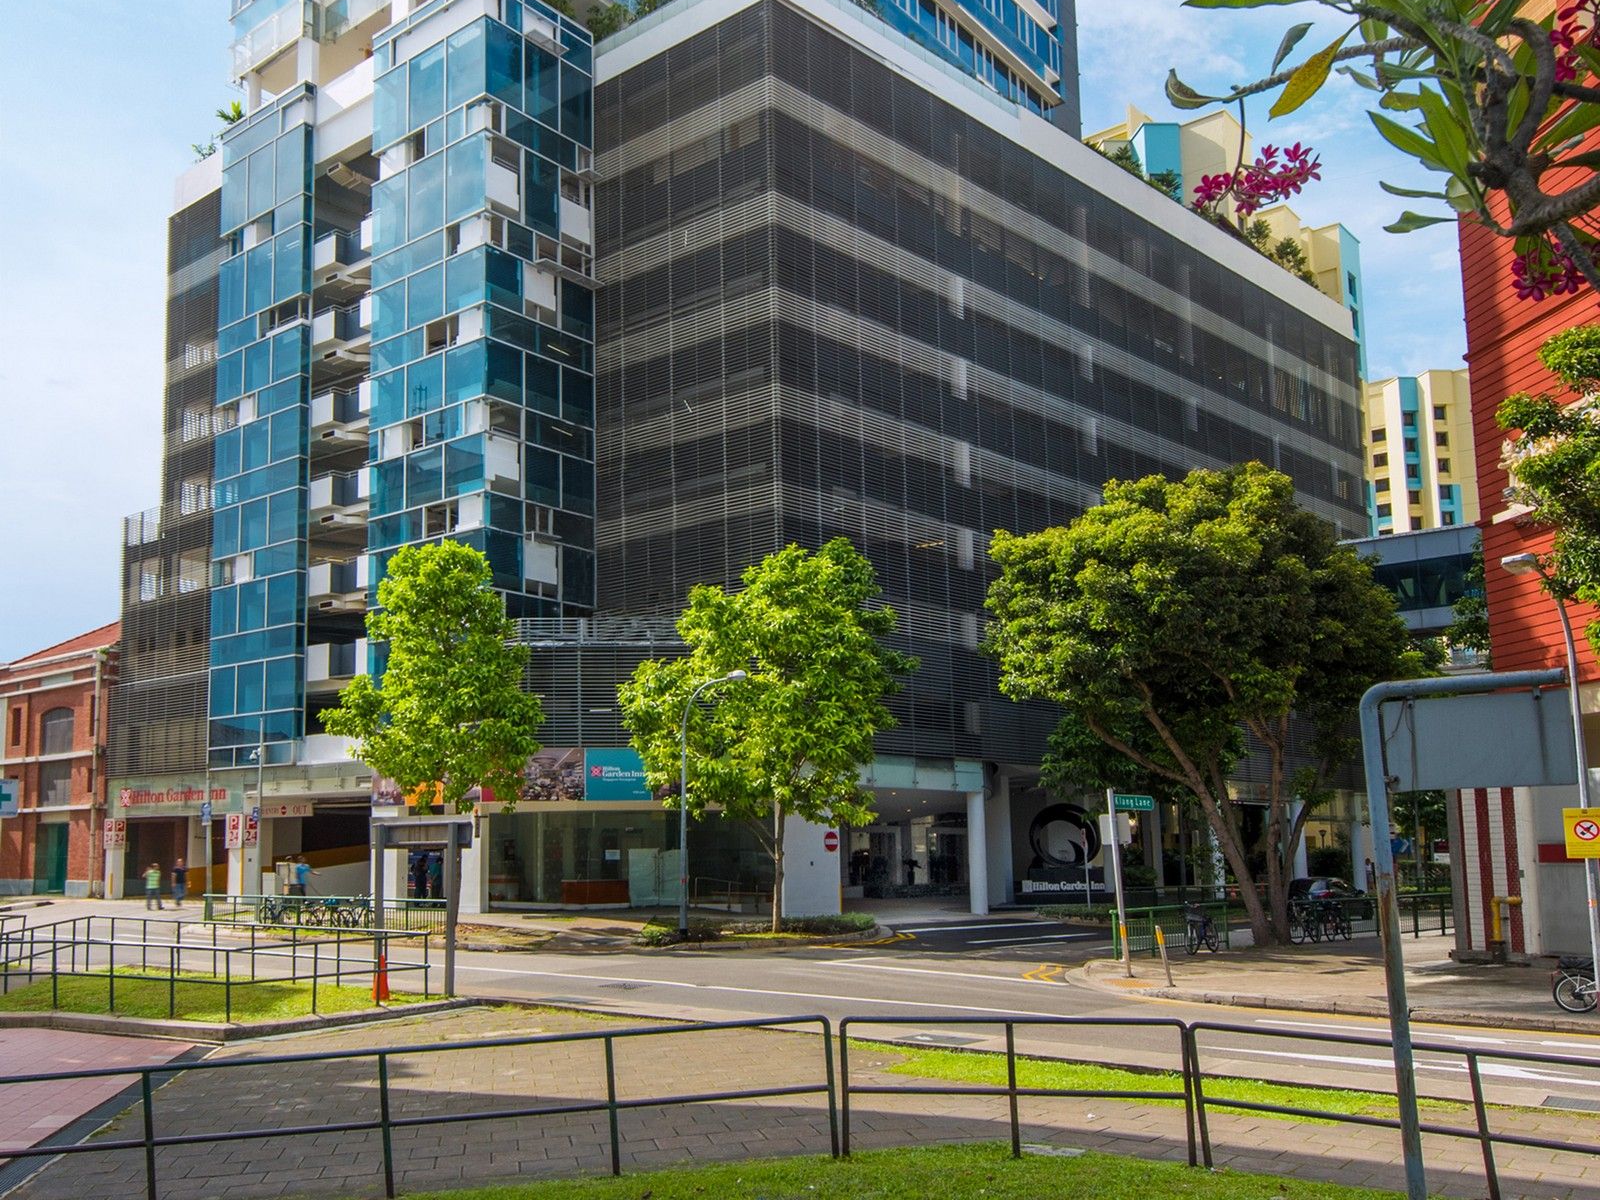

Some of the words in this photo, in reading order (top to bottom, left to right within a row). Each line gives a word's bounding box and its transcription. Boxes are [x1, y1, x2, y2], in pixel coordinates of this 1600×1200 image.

[131, 789, 164, 804] Hilton
[166, 786, 204, 802] Garden
[1033, 881, 1060, 891] Hilton
[1091, 881, 1105, 890] Inn
